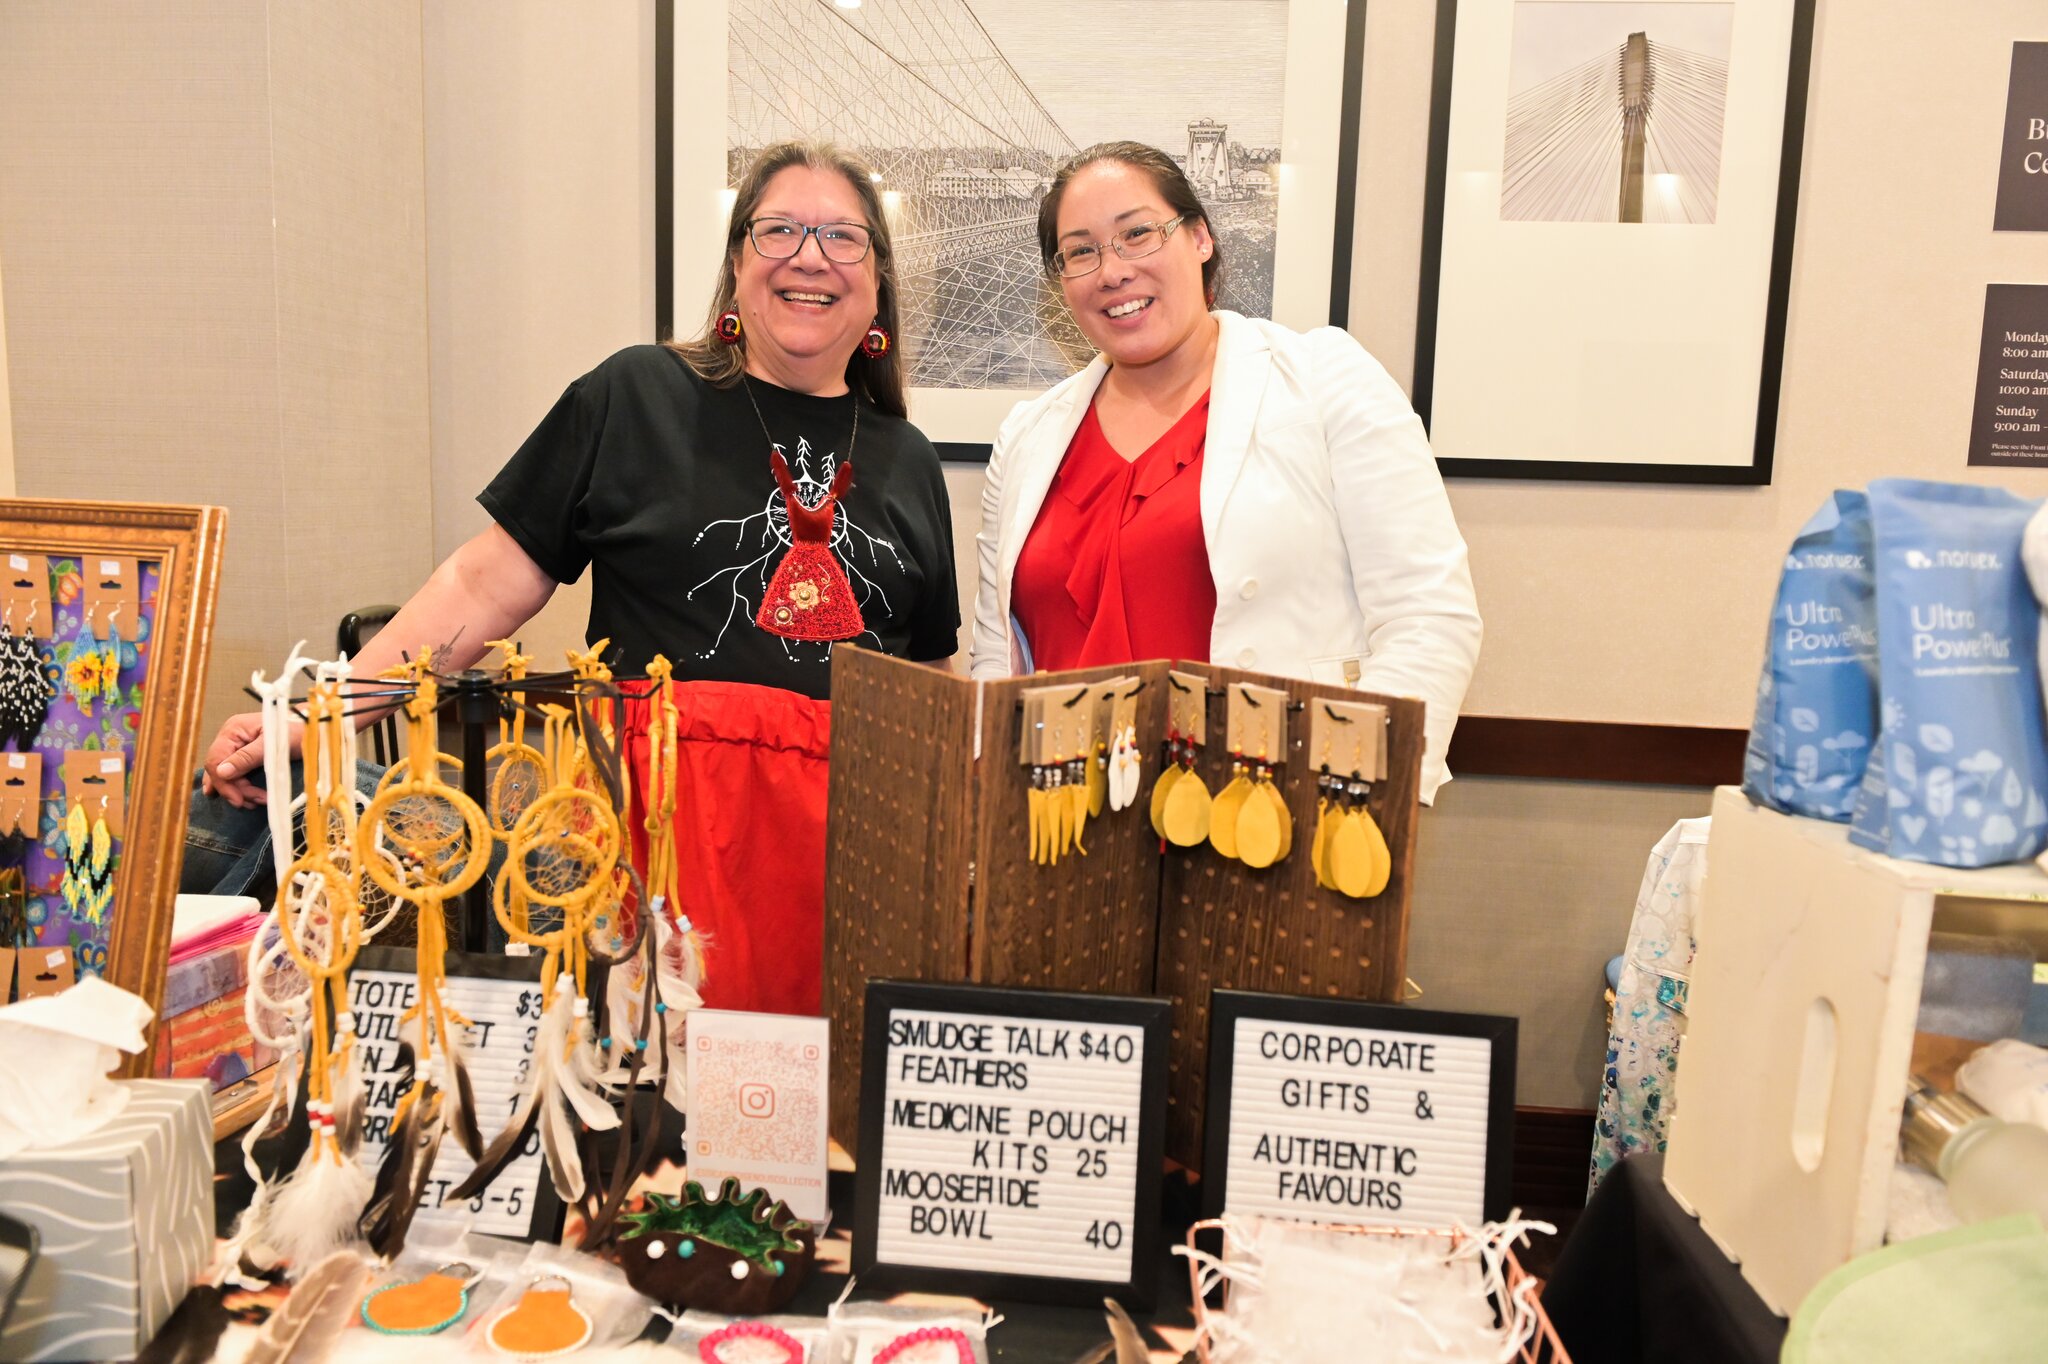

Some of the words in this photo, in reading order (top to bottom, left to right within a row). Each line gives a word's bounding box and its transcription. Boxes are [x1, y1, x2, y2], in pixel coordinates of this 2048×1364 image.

[2027, 118, 2048, 140] B
[2002, 346, 2029, 358] 8:00
[2031, 349, 2048, 358] am
[1999, 385, 2030, 396] 10:00
[1994, 422, 2020, 433] 9:00
[2022, 423, 2041, 432] am
[1995, 404, 2040, 419] Sunday
[354, 979, 415, 1009] TOTE
[888, 1019, 993, 1053] SMUDGE
[1004, 1026, 1070, 1060] TALK
[1079, 1030, 1134, 1063] $40
[1260, 1031, 1436, 1073] CORPORATE
[901, 1054, 1028, 1090] FEATHERS
[1281, 1079, 1370, 1114] GIFTS
[1415, 1090, 1434, 1120] &
[892, 1099, 1010, 1135] MEDICINE
[1028, 1109, 1127, 1144] POUCH
[972, 1140, 1048, 1174] KITS
[1076, 1149, 1107, 1178] 25
[1253, 1133, 1418, 1177] AUTHENTIC
[885, 1168, 1039, 1209] MOOSEHIDE
[1278, 1171, 1402, 1210] FAVOURS
[910, 1205, 993, 1240] BOWL
[1085, 1220, 1122, 1250] 40
